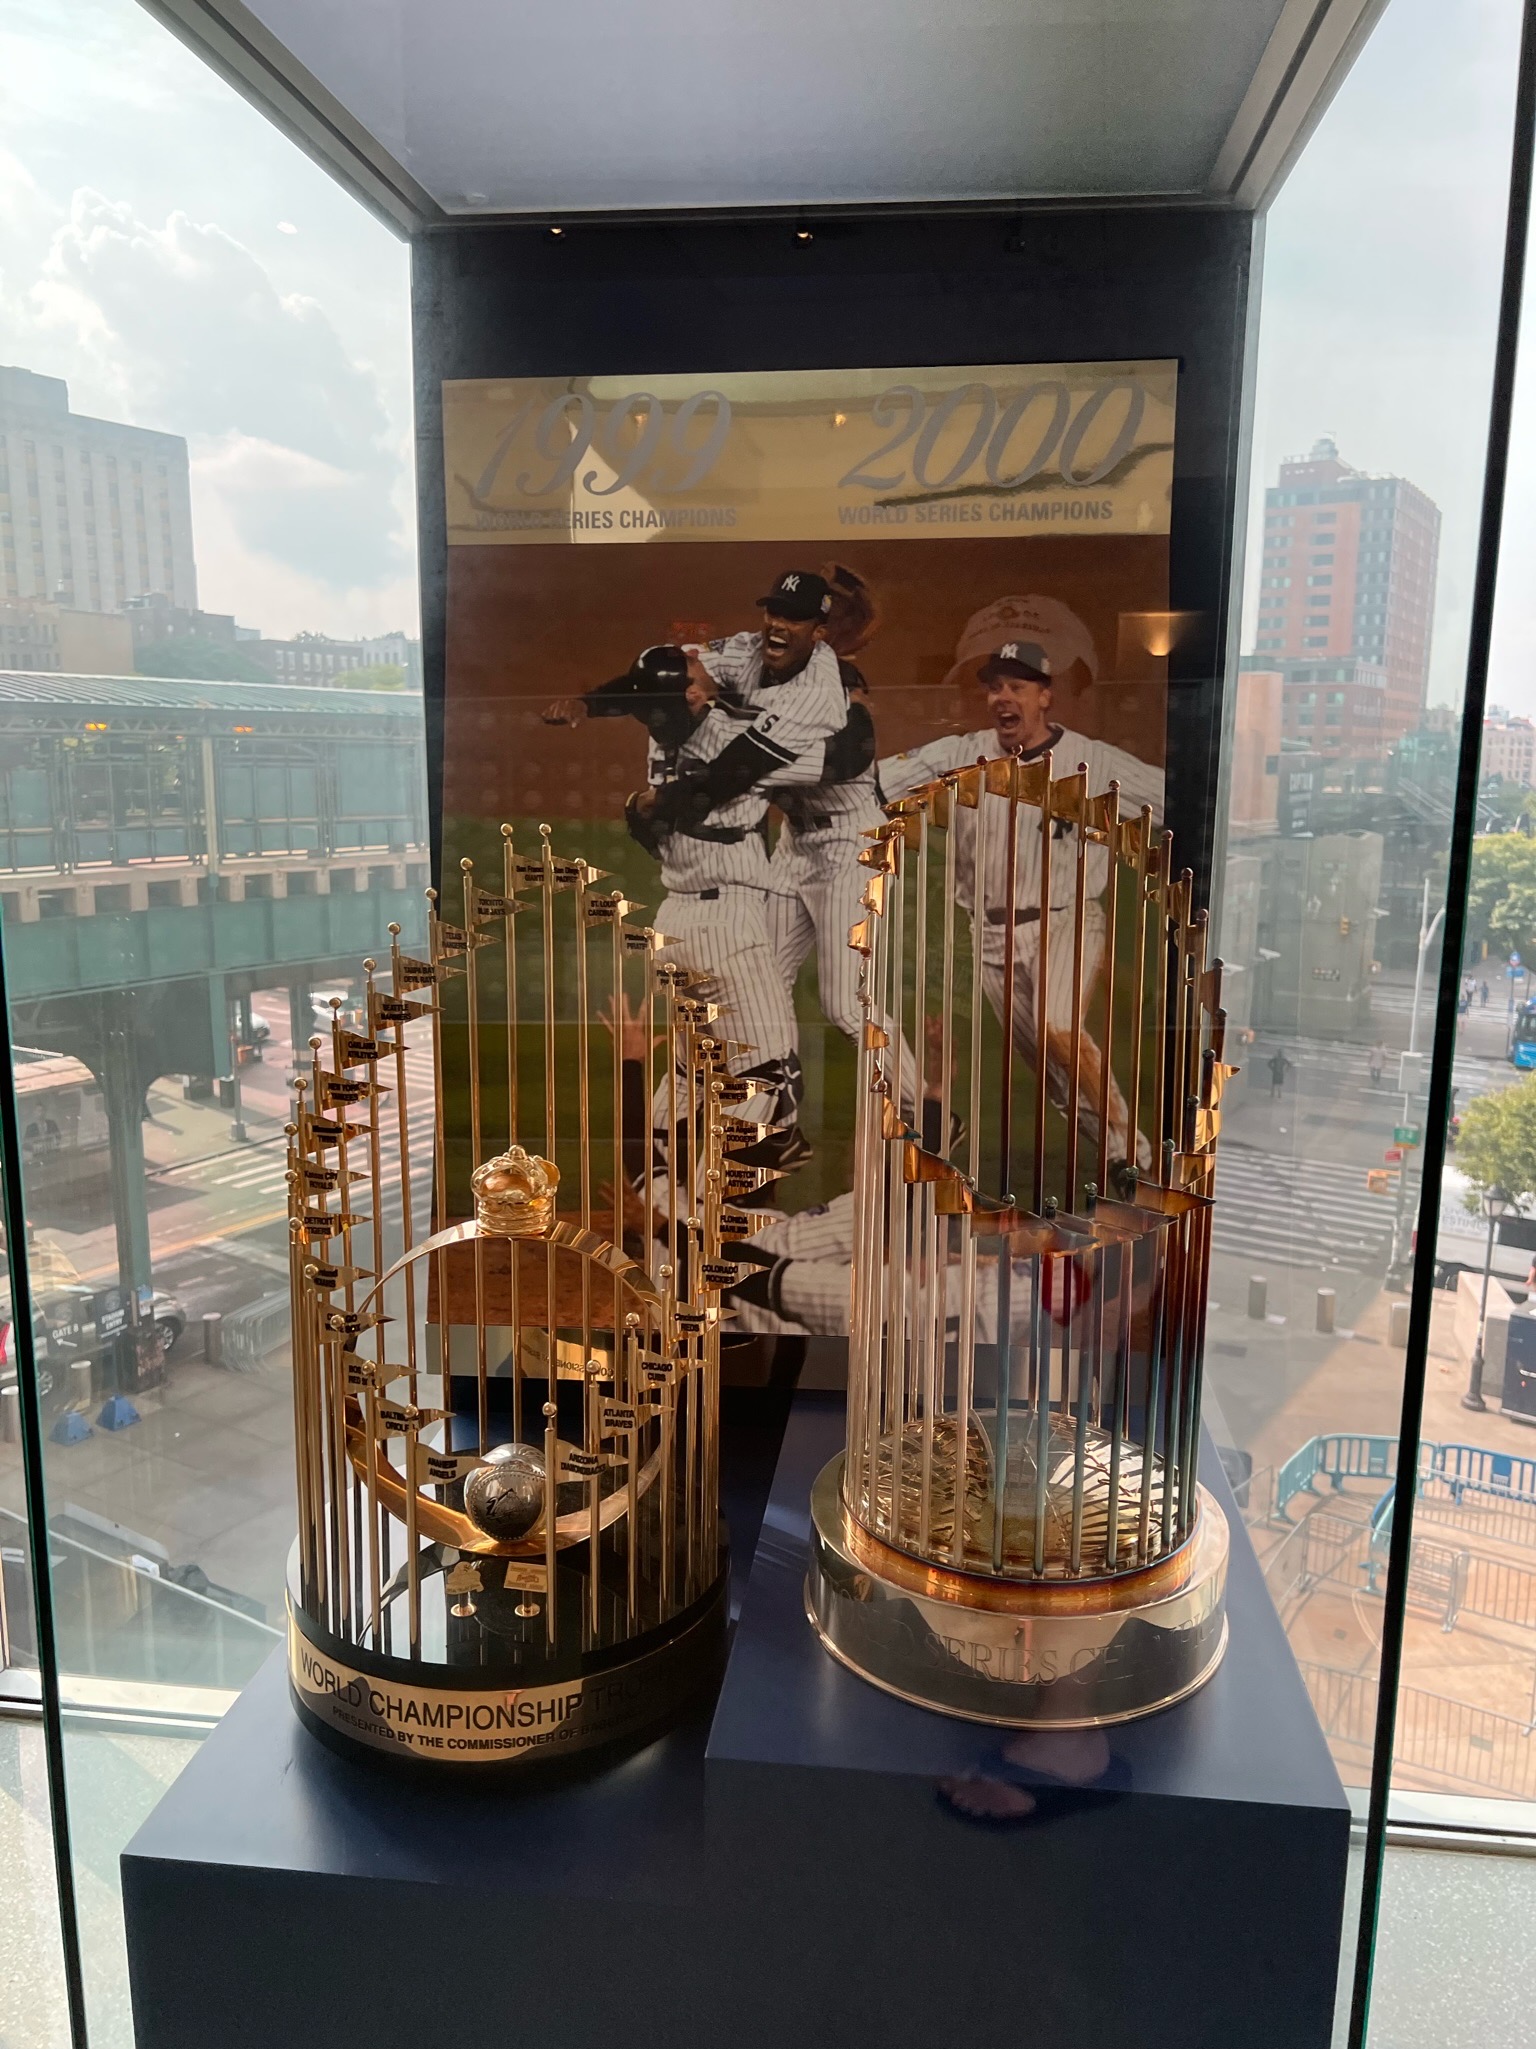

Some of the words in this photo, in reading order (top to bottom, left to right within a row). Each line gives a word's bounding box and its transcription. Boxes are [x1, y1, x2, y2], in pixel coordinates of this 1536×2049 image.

[836, 380, 1145, 491] 2000
[476, 389, 732, 498] 1999
[837, 505, 907, 525] WORLD
[914, 502, 983, 524] SERIES
[988, 500, 1114, 522] CHAMPIONS
[475, 512, 542, 531] WORLD
[552, 510, 613, 530] SERIES
[619, 508, 738, 528] CHAMPIONS
[725, 1169, 756, 1179] HOUSTON
[727, 1179, 754, 1189] ASTROS
[720, 1214, 749, 1224] FLORIDA
[701, 1264, 739, 1274] COLORADO
[105, 1319, 123, 1330] ENTRY
[680, 1323, 700, 1333] REDS
[52, 1325, 73, 1339] GATE
[641, 1361, 673, 1372] CHICAGO
[647, 1372, 667, 1383] CUBS
[603, 1408, 635, 1418] ATLANTA
[604, 1418, 633, 1429] BRAVES
[427, 1456, 458, 1468] ANAHEIM
[568, 1452, 599, 1463] ARIZONA
[428, 1467, 457, 1480] ANGELS
[925, 1632, 1060, 1687] SERIES
[300, 1647, 363, 1708] WORLD
[368, 1690, 584, 1731] CHAMPIONSHIP
[332, 1705, 395, 1739] PRESENTED
[397, 1730, 415, 1745] BY
[417, 1734, 445, 1749] THE
[446, 1732, 556, 1750] COMMISSIONER
[558, 1727, 579, 1741] OF
